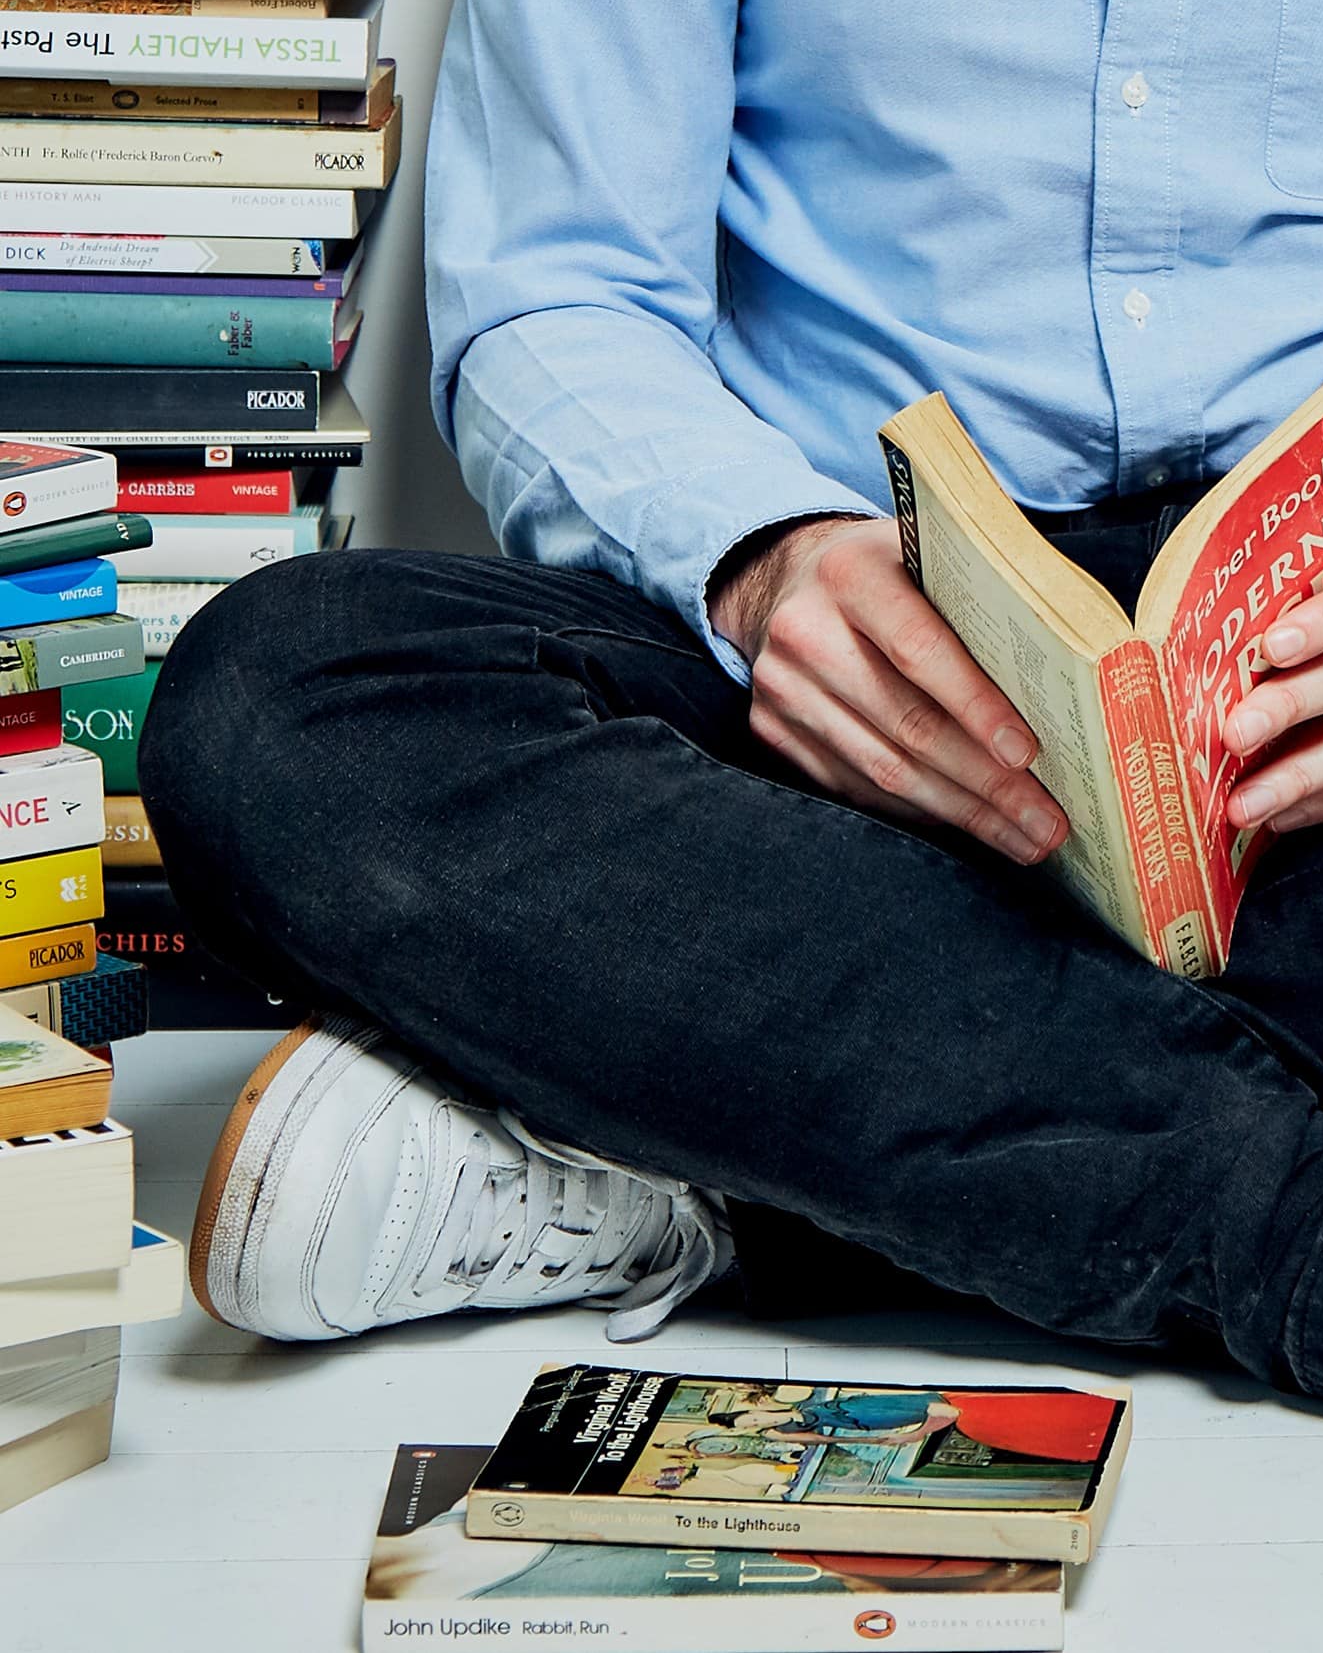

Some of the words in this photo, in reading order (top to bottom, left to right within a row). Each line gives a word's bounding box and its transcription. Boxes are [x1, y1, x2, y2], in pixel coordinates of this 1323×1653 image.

[280, 0, 317, 10] Robert
[1, 29, 53, 53] Past
[66, 31, 115, 56] The
[128, 33, 244, 59] HADLEY
[256, 37, 342, 63] TESSA
[314, 153, 365, 171] PICADOR
[15, 190, 68, 203] HISTORY
[72, 192, 102, 203] MAN
[5, 247, 46, 261] DICK
[241, 317, 253, 350] Faber
[246, 389, 306, 410] PICADOR
[247, 451, 296, 459] PENGUIN
[301, 451, 352, 459] CLASSICS
[128, 480, 195, 497] CARRÈRE
[231, 484, 279, 496] VINTAGE
[59, 585, 104, 602] VINTAGE
[1166, 611, 1193, 667] The
[1193, 529, 1258, 640] Faber
[60, 648, 126, 668] CAMBRIDGE
[61, 708, 134, 741] SON
[1123, 735, 1155, 831] MODERN
[1141, 825, 1172, 889] VERSE
[96, 933, 186, 952] CHIES
[29, 941, 85, 969] PICADOR
[614, 1375, 665, 1433] Lighthouse
[572, 1403, 614, 1444] Virginia
[606, 1427, 635, 1450] the
[597, 1445, 626, 1464] To
[405, 1496, 419, 1526] MODERN
[412, 1459, 428, 1497] CLASSICS
[675, 1514, 692, 1529] To
[697, 1516, 719, 1529] the
[723, 1517, 802, 1534] Lighthouse
[384, 1617, 433, 1638] John
[440, 1617, 512, 1640] Updike
[521, 1620, 578, 1637] Rabbit,
[579, 1620, 611, 1636] Run
